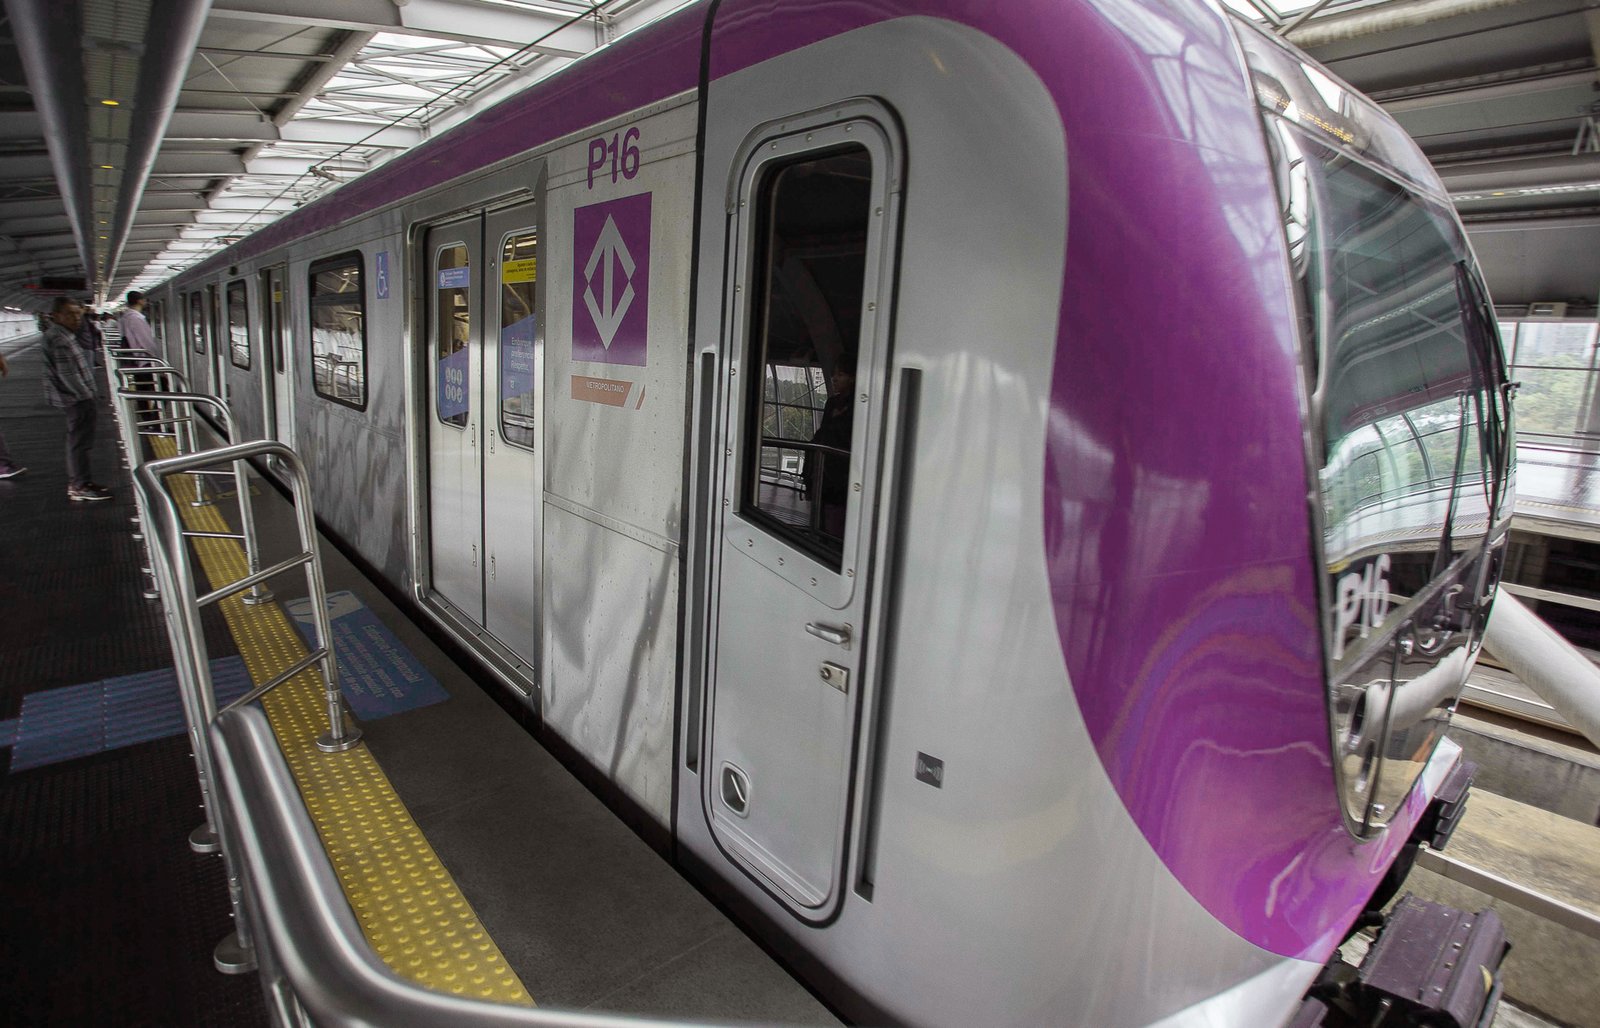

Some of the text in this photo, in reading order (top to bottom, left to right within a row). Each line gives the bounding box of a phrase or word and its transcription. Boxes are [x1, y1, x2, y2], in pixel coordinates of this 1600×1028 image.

[588, 127, 640, 190] P16
[585, 380, 625, 393] METROPOLITANO
[1333, 553, 1391, 661] P16
